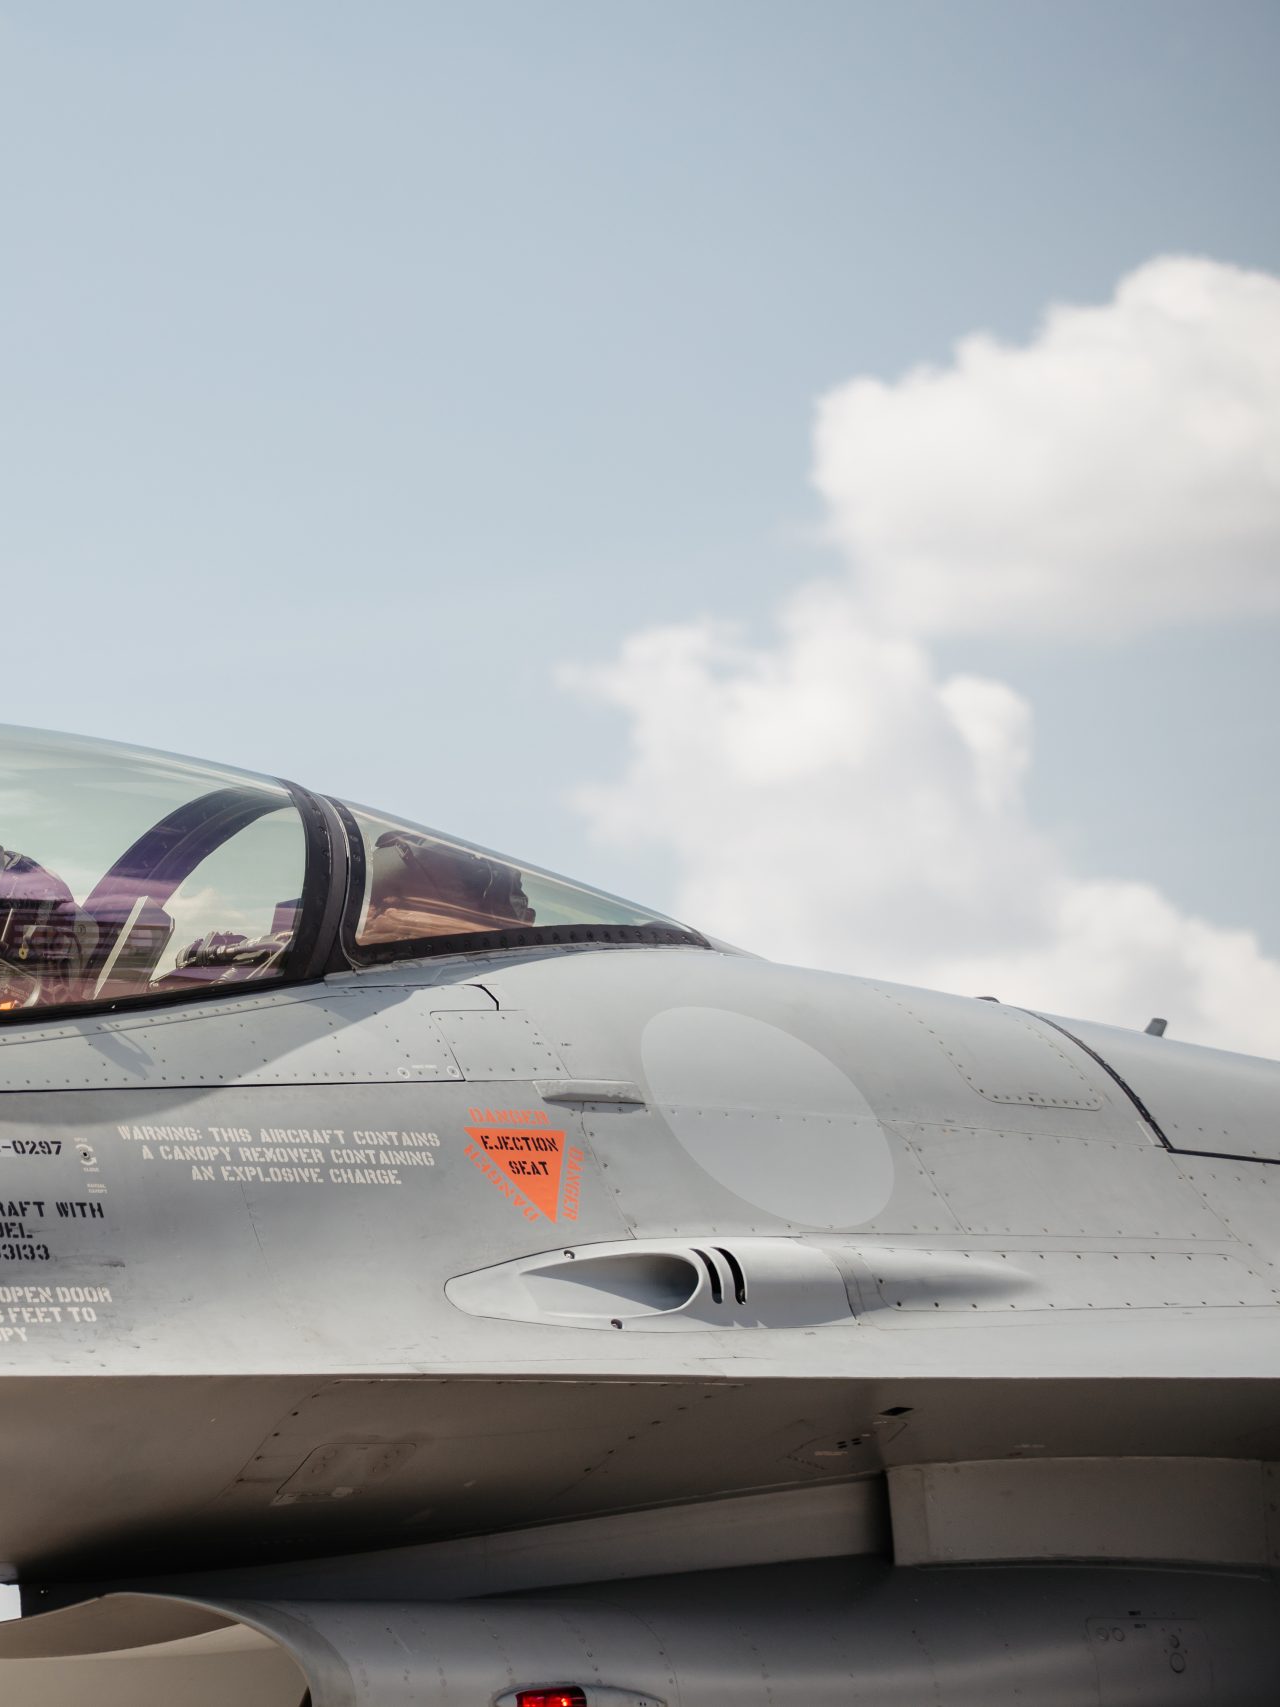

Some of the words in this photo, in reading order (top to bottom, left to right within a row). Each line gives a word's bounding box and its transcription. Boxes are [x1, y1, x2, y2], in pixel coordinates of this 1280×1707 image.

[469, 1106, 550, 1125] DANGER
[117, 1125, 203, 1141] WARNING:
[208, 1127, 252, 1142] THIS
[260, 1128, 345, 1145] AIRCRAFT
[352, 1130, 441, 1147] CONTAINS
[480, 1135, 559, 1152] EJECTION
[142, 1145, 154, 1160] A
[159, 1145, 232, 1161] CANOPY
[238, 1147, 326, 1164] REMOVER
[330, 1149, 435, 1166] CONTAINING
[191, 1165, 216, 1181] AN
[220, 1166, 324, 1183] EXPLOSIVE
[328, 1167, 402, 1185] CHARGE
[508, 1160, 549, 1175] SEAT
[463, 1143, 540, 1222] DANGER
[561, 1146, 585, 1221] DANGER
[56, 1201, 104, 1218] WITH
[55, 1286, 113, 1303] DOOR
[7, 1307, 62, 1323] FEET
[66, 1307, 97, 1322] TO
